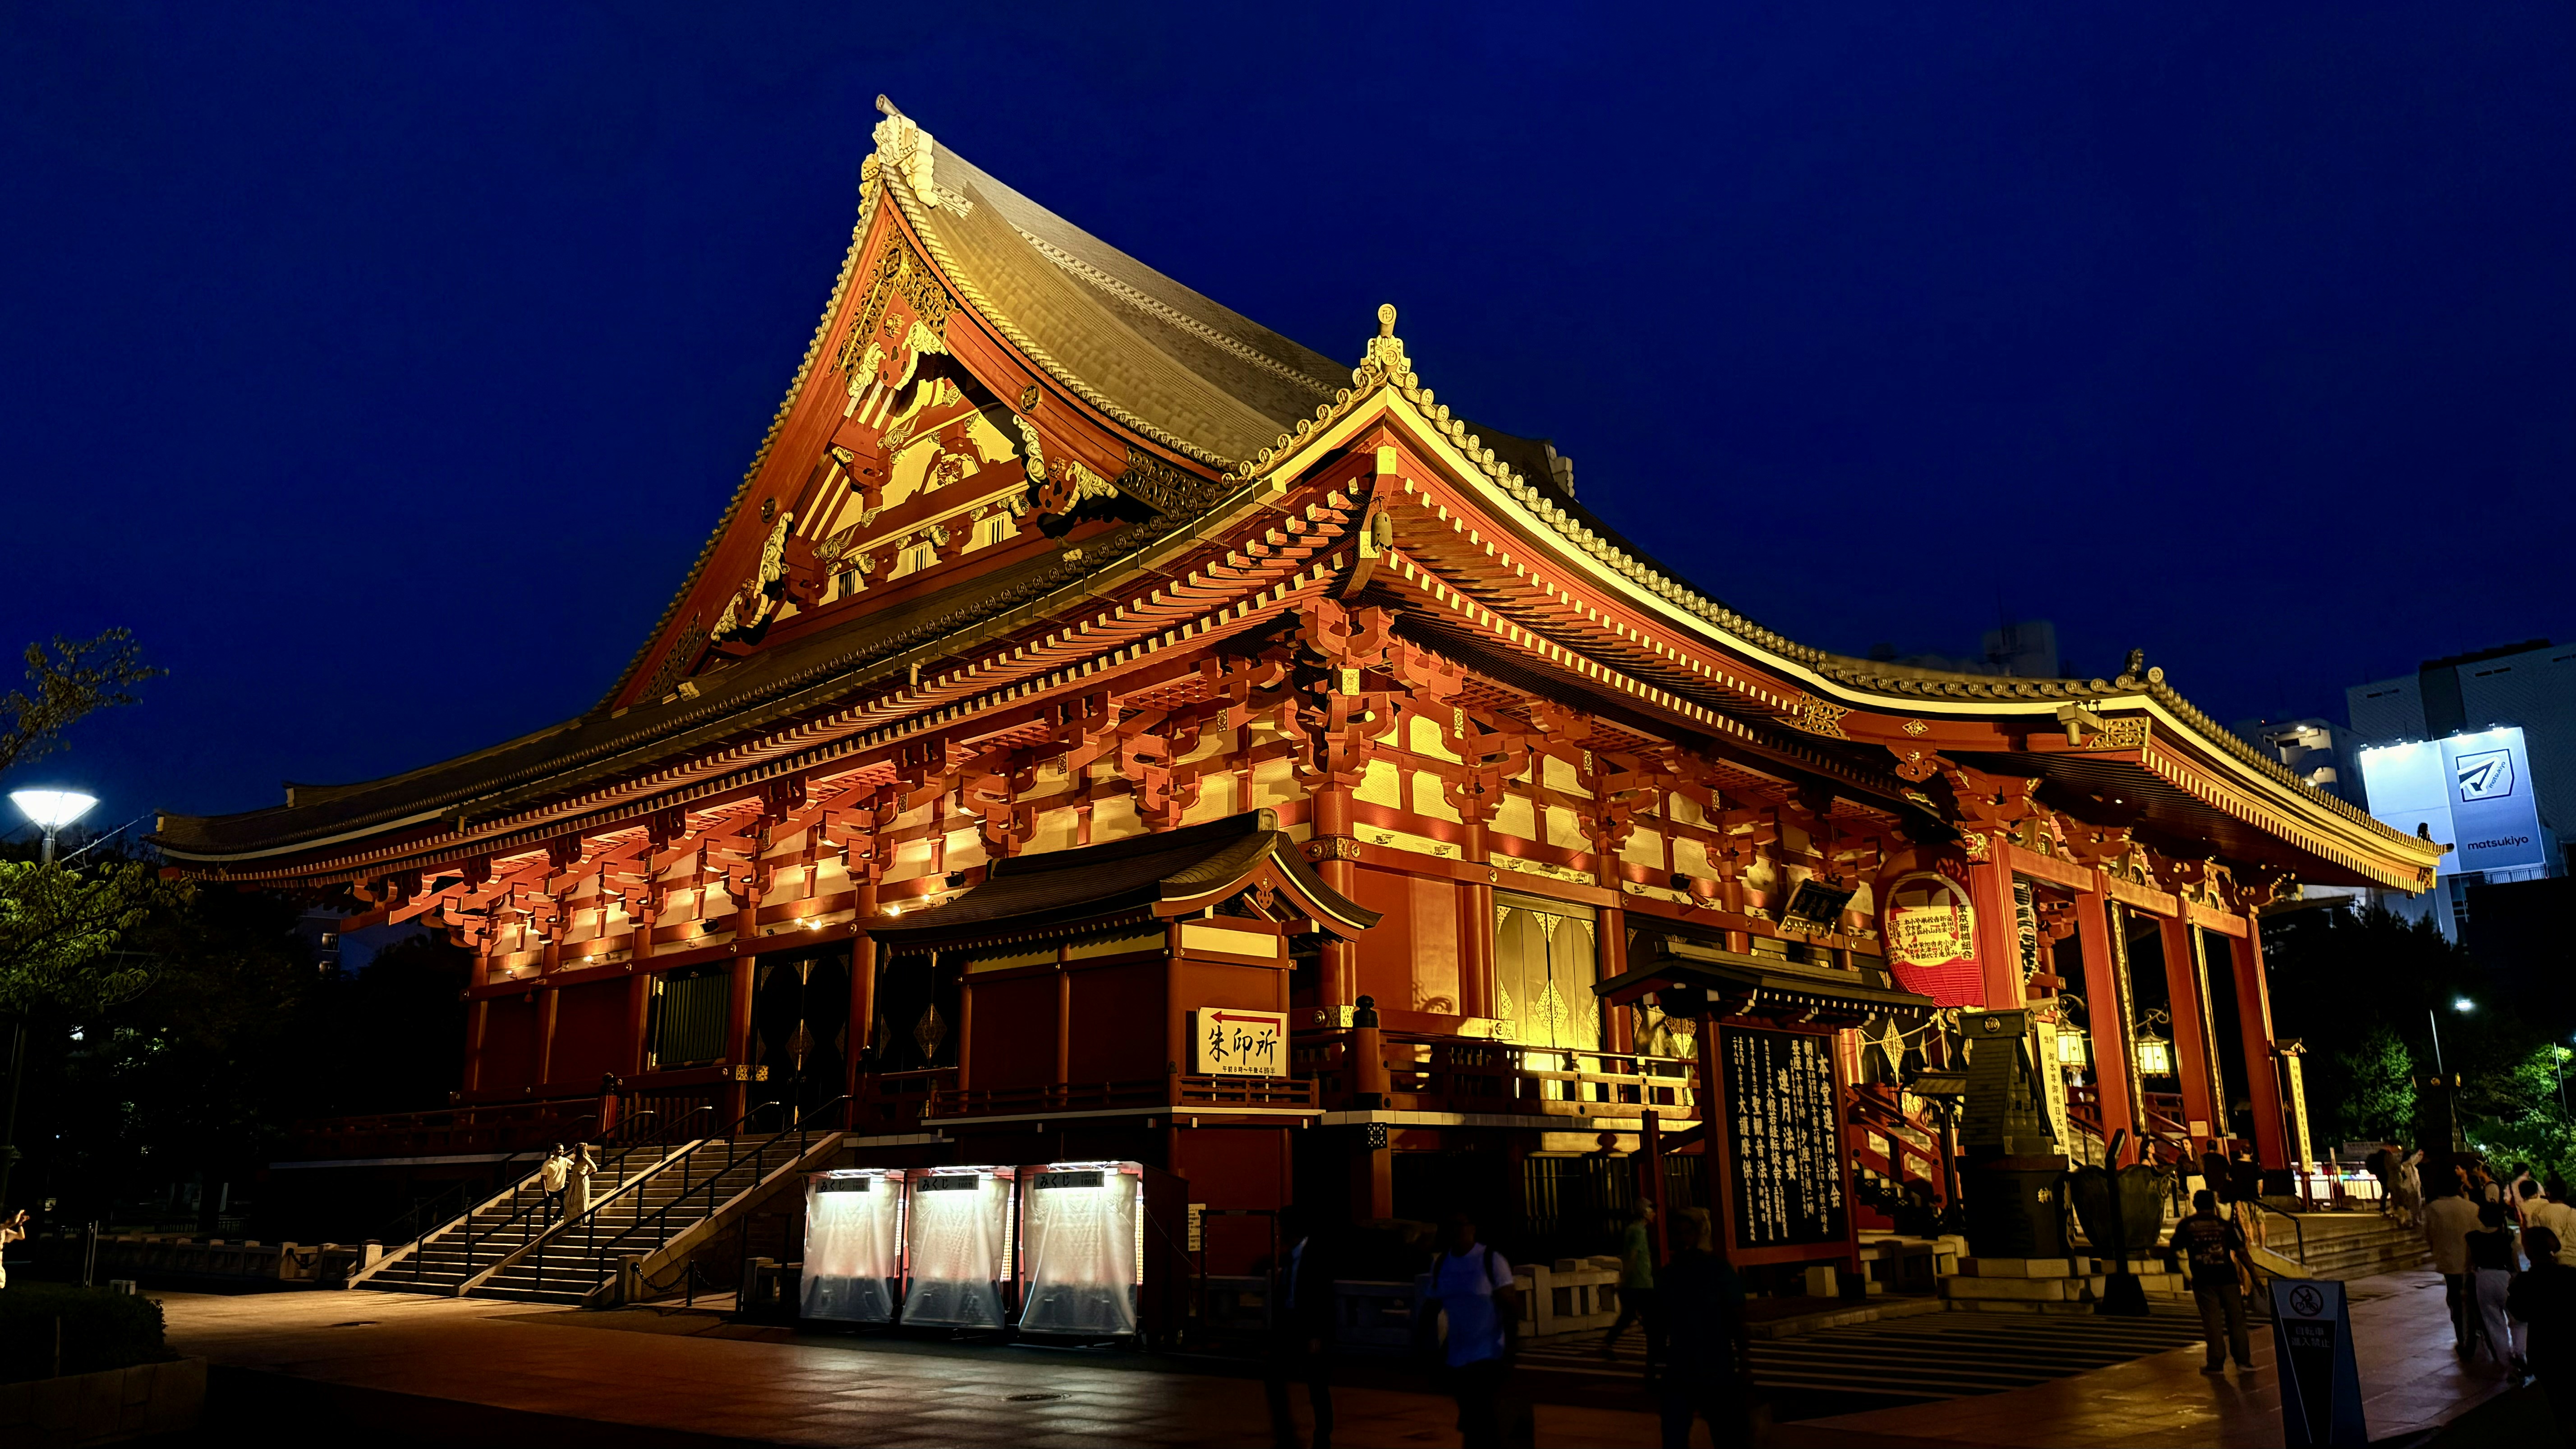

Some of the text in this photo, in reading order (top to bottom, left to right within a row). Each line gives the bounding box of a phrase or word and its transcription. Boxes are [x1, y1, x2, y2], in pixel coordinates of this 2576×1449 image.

[2489, 761, 2506, 789] matsukiyo
[2468, 835, 2529, 851] matsukiyo
[1957, 904, 1973, 959] 東京新橋組合
[1208, 1025, 1277, 1066] 朱印所
[922, 1178, 948, 1190] みくじ
[1040, 1174, 1070, 1187] みくじ
